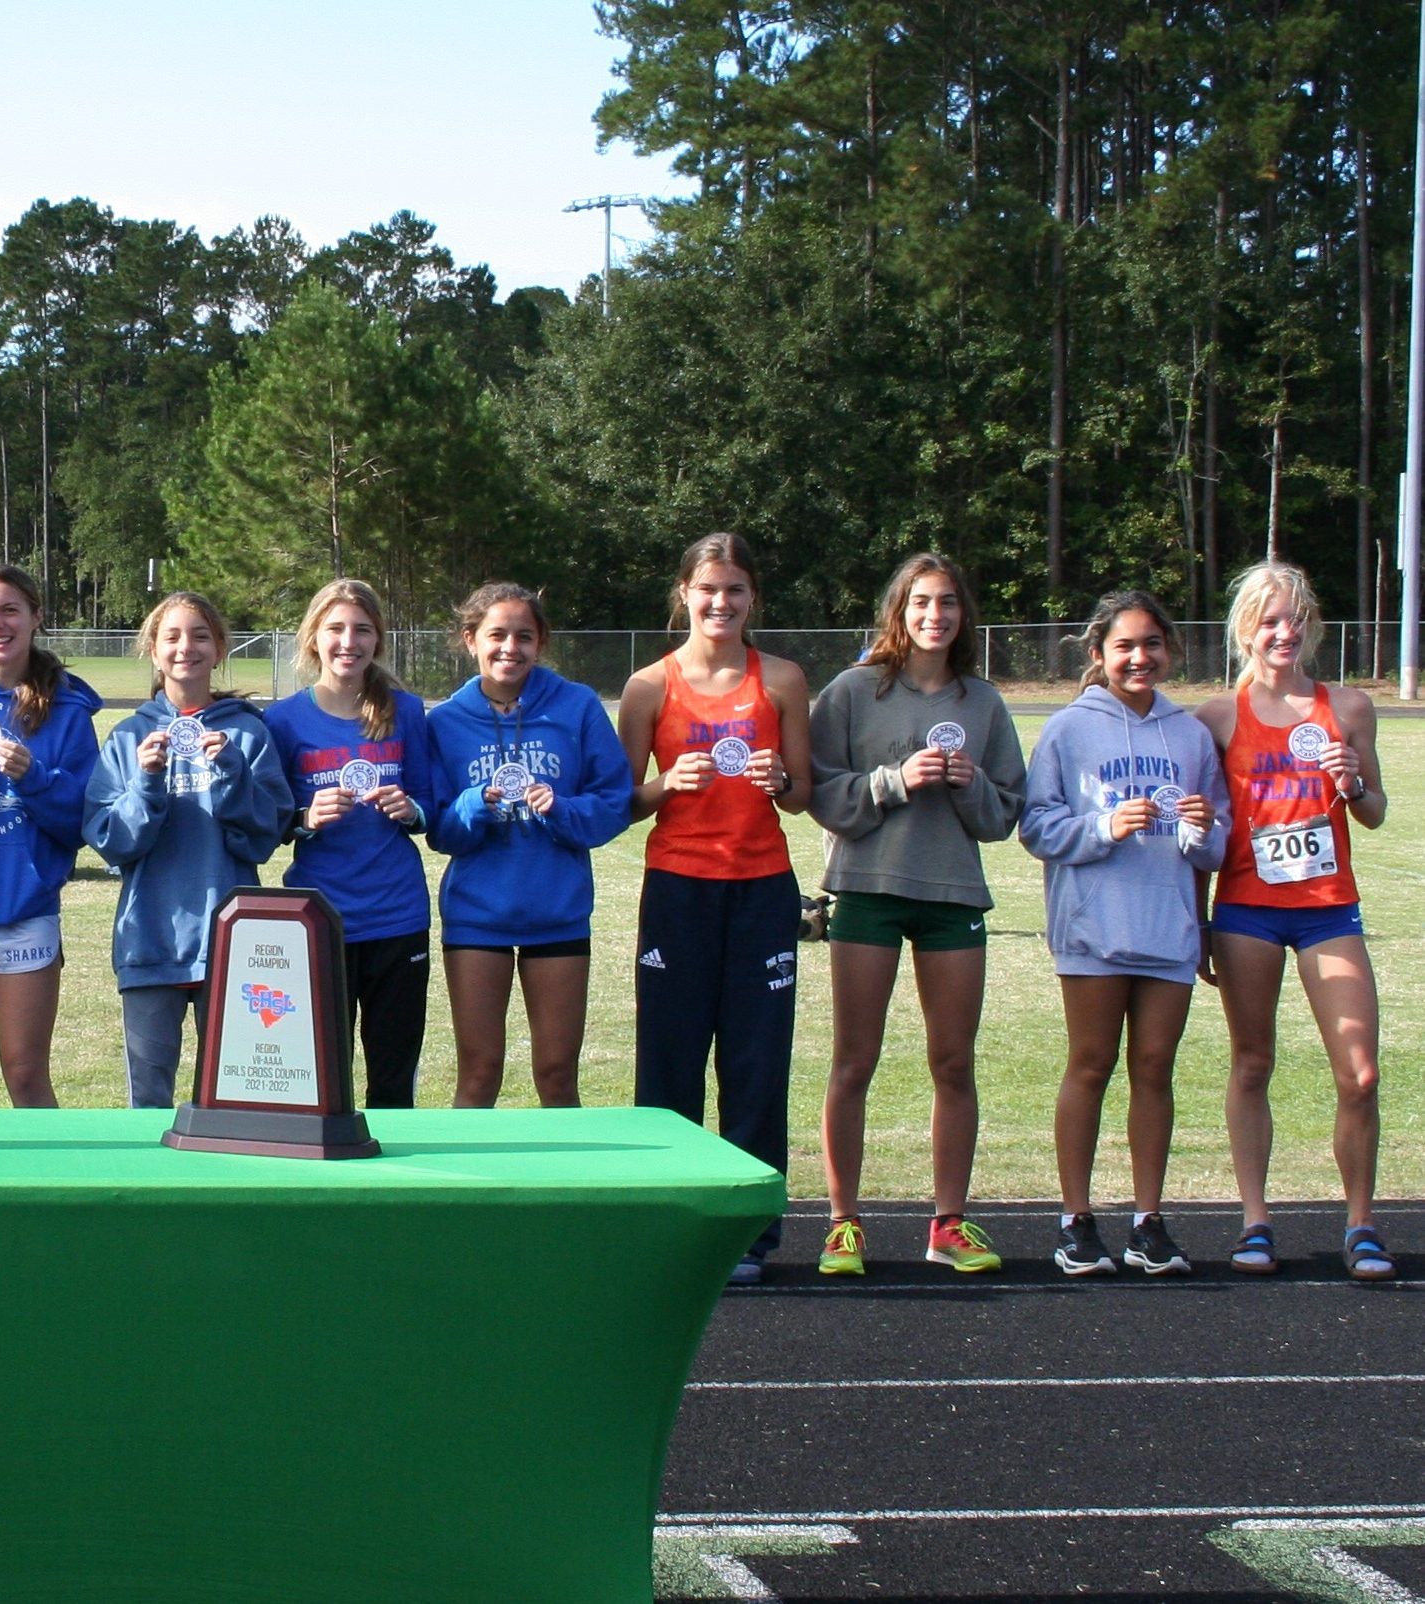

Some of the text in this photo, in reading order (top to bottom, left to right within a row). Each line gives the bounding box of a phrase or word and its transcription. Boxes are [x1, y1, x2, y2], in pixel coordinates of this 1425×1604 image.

[686, 720, 755, 744] JAMES
[509, 740, 543, 752] RVER
[312, 769, 342, 786] CROS
[1099, 756, 1180, 785] MAY RIVER
[1267, 831, 1320, 862] 206
[6, 946, 52, 962] SHARKS
[254, 944, 284, 956] REGION
[247, 956, 290, 969] CHAMPION
[241, 983, 297, 1015] SCHSL
[254, 1043, 280, 1054] REGION
[252, 1056, 283, 1066] VII-AAAA
[223, 1065, 311, 1081] GIRLS CROSS COUNTRY
[245, 1079, 290, 1092] 2021-2022
